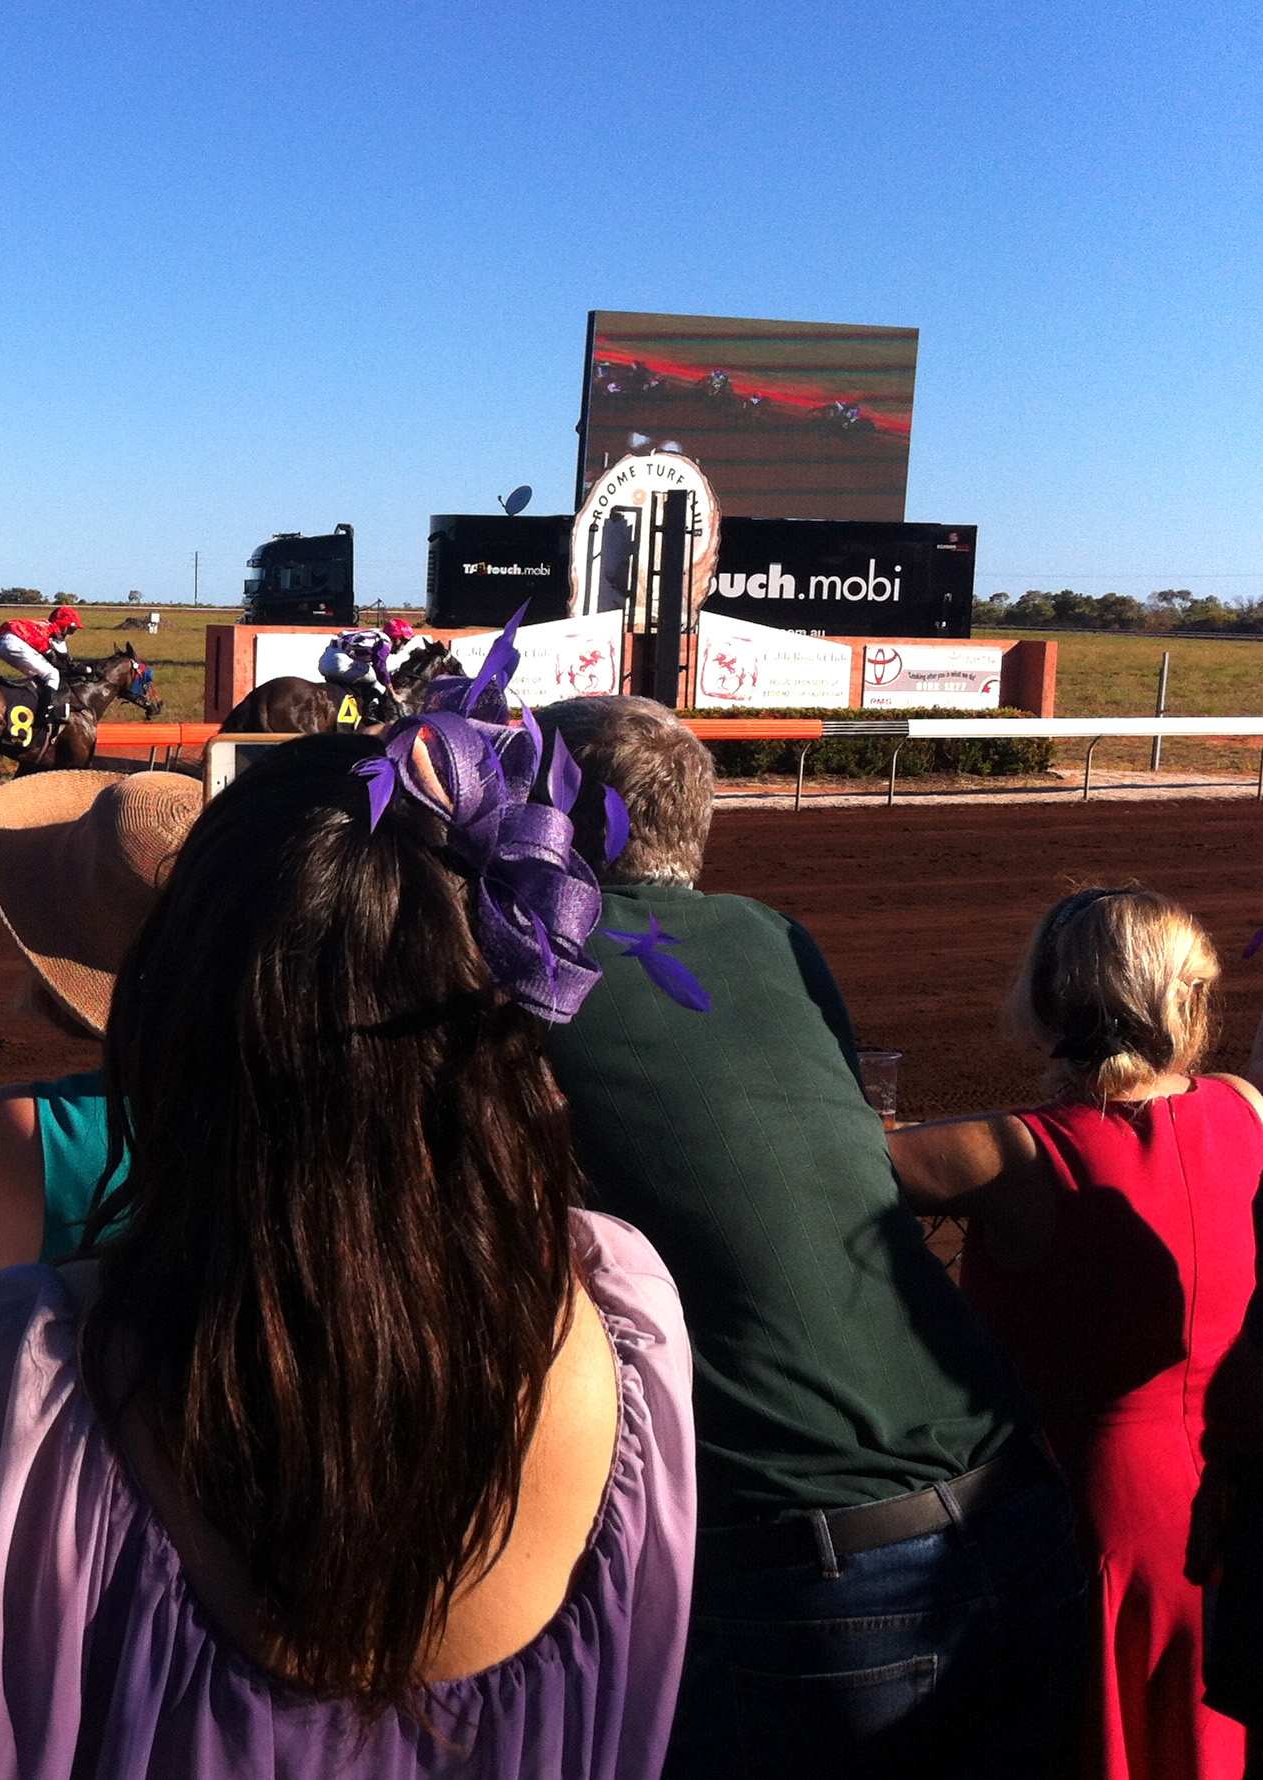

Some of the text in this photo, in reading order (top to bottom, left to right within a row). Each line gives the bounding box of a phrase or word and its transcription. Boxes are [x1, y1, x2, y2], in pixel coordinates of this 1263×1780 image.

[647, 463, 685, 485] TURF
[10, 705, 34, 747] 8
[337, 694, 362, 731] 4
